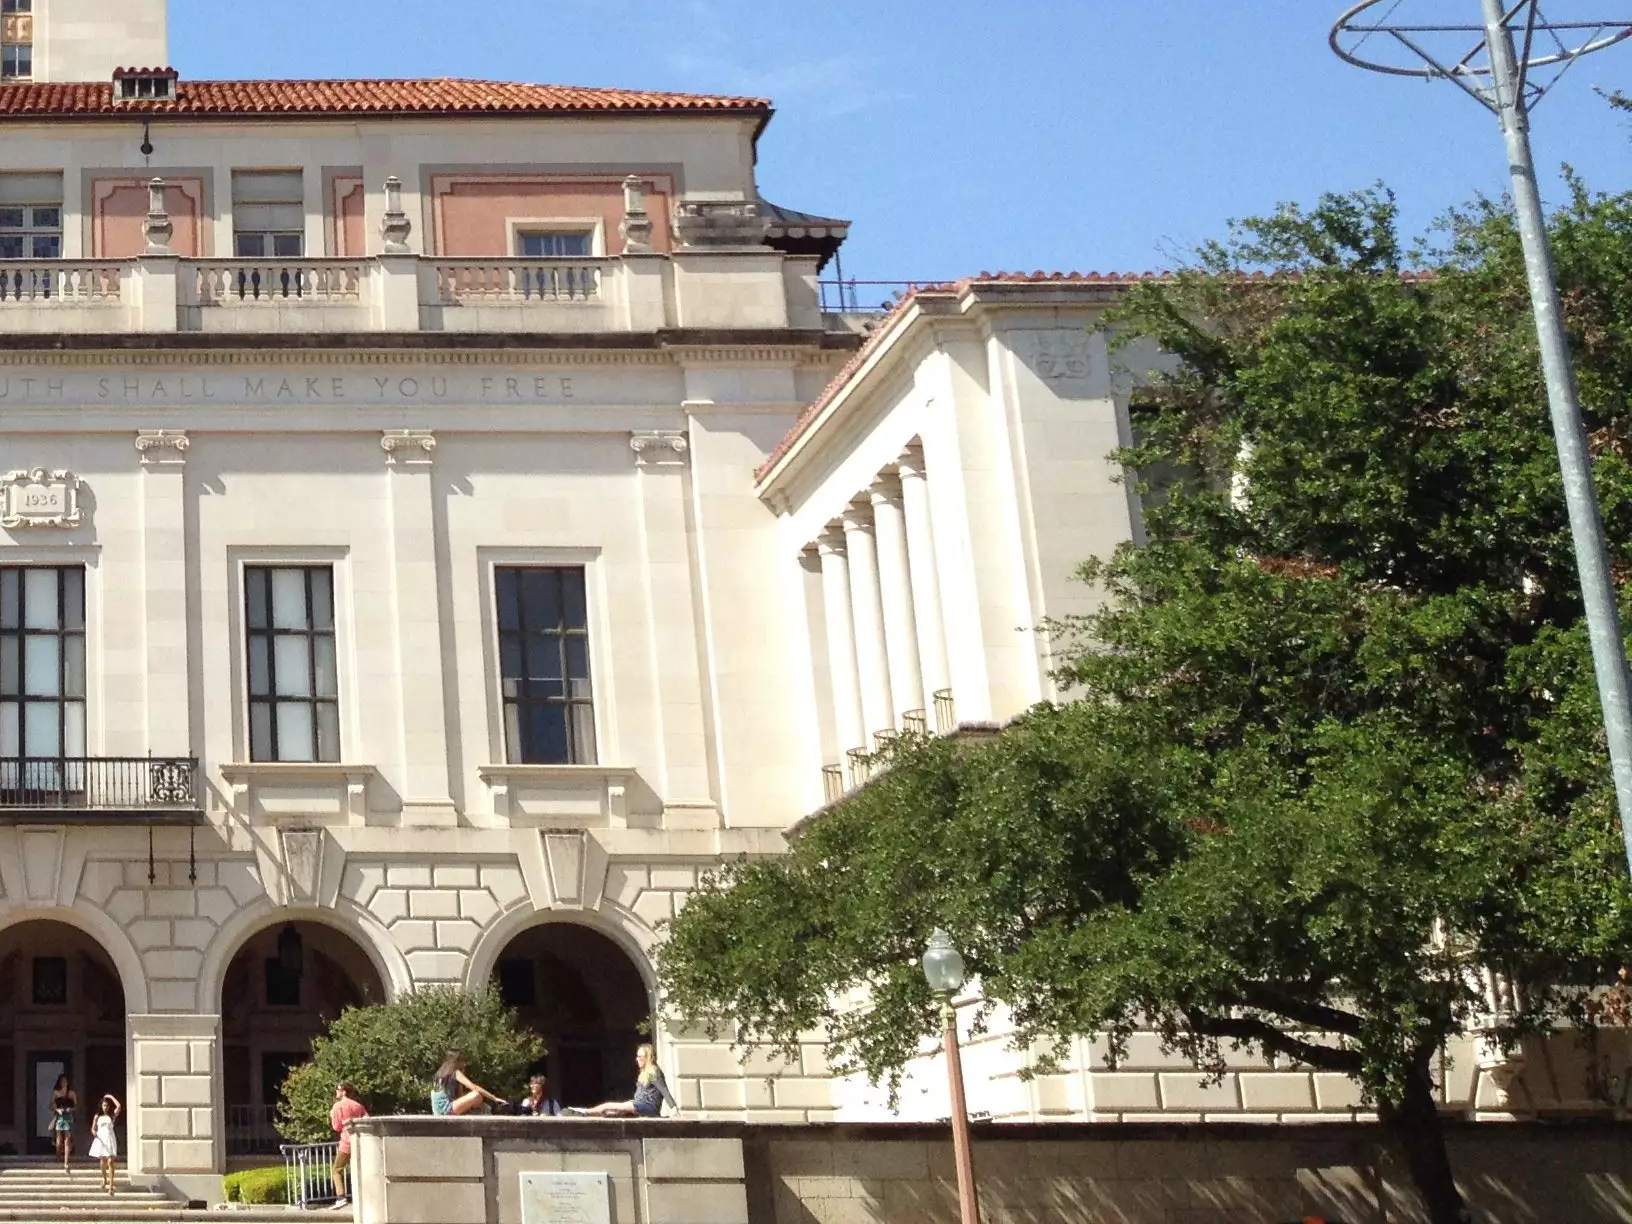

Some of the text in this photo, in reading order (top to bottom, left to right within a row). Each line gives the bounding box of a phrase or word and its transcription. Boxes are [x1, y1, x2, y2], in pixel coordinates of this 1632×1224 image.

[97, 378, 217, 398] SHALL
[244, 377, 346, 398] MAKE
[373, 377, 448, 398] YOU
[480, 377, 575, 398] FREE
[25, 494, 58, 507] 1936
